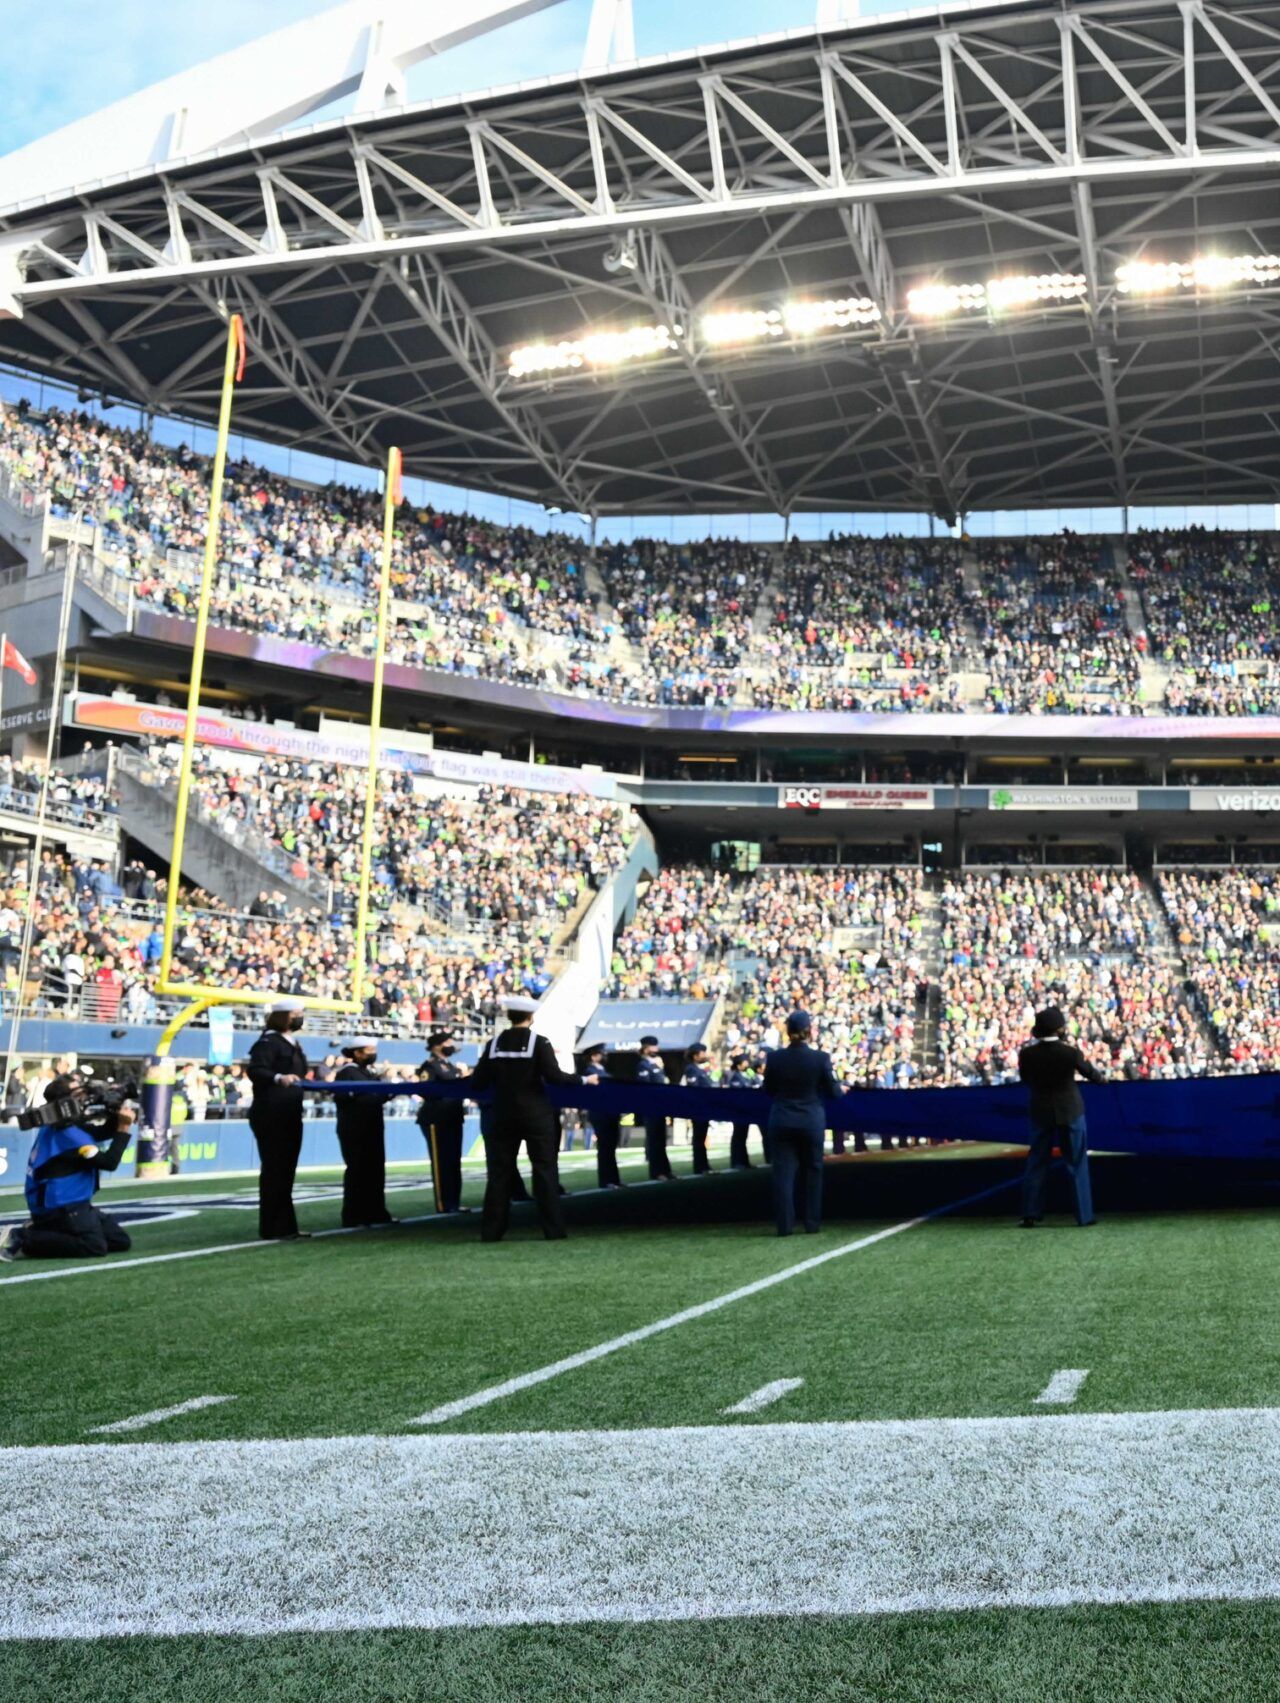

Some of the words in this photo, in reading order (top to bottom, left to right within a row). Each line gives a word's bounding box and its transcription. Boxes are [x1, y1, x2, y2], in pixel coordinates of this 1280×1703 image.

[139, 710, 184, 733] Gave
[239, 730, 301, 749] through
[306, 739, 331, 754] the
[335, 744, 371, 762] nigh
[441, 759, 467, 776] flag
[471, 765, 498, 777] was
[502, 766, 526, 781] still
[785, 788, 821, 807] EQC
[598, 1018, 704, 1029] LUMEN
